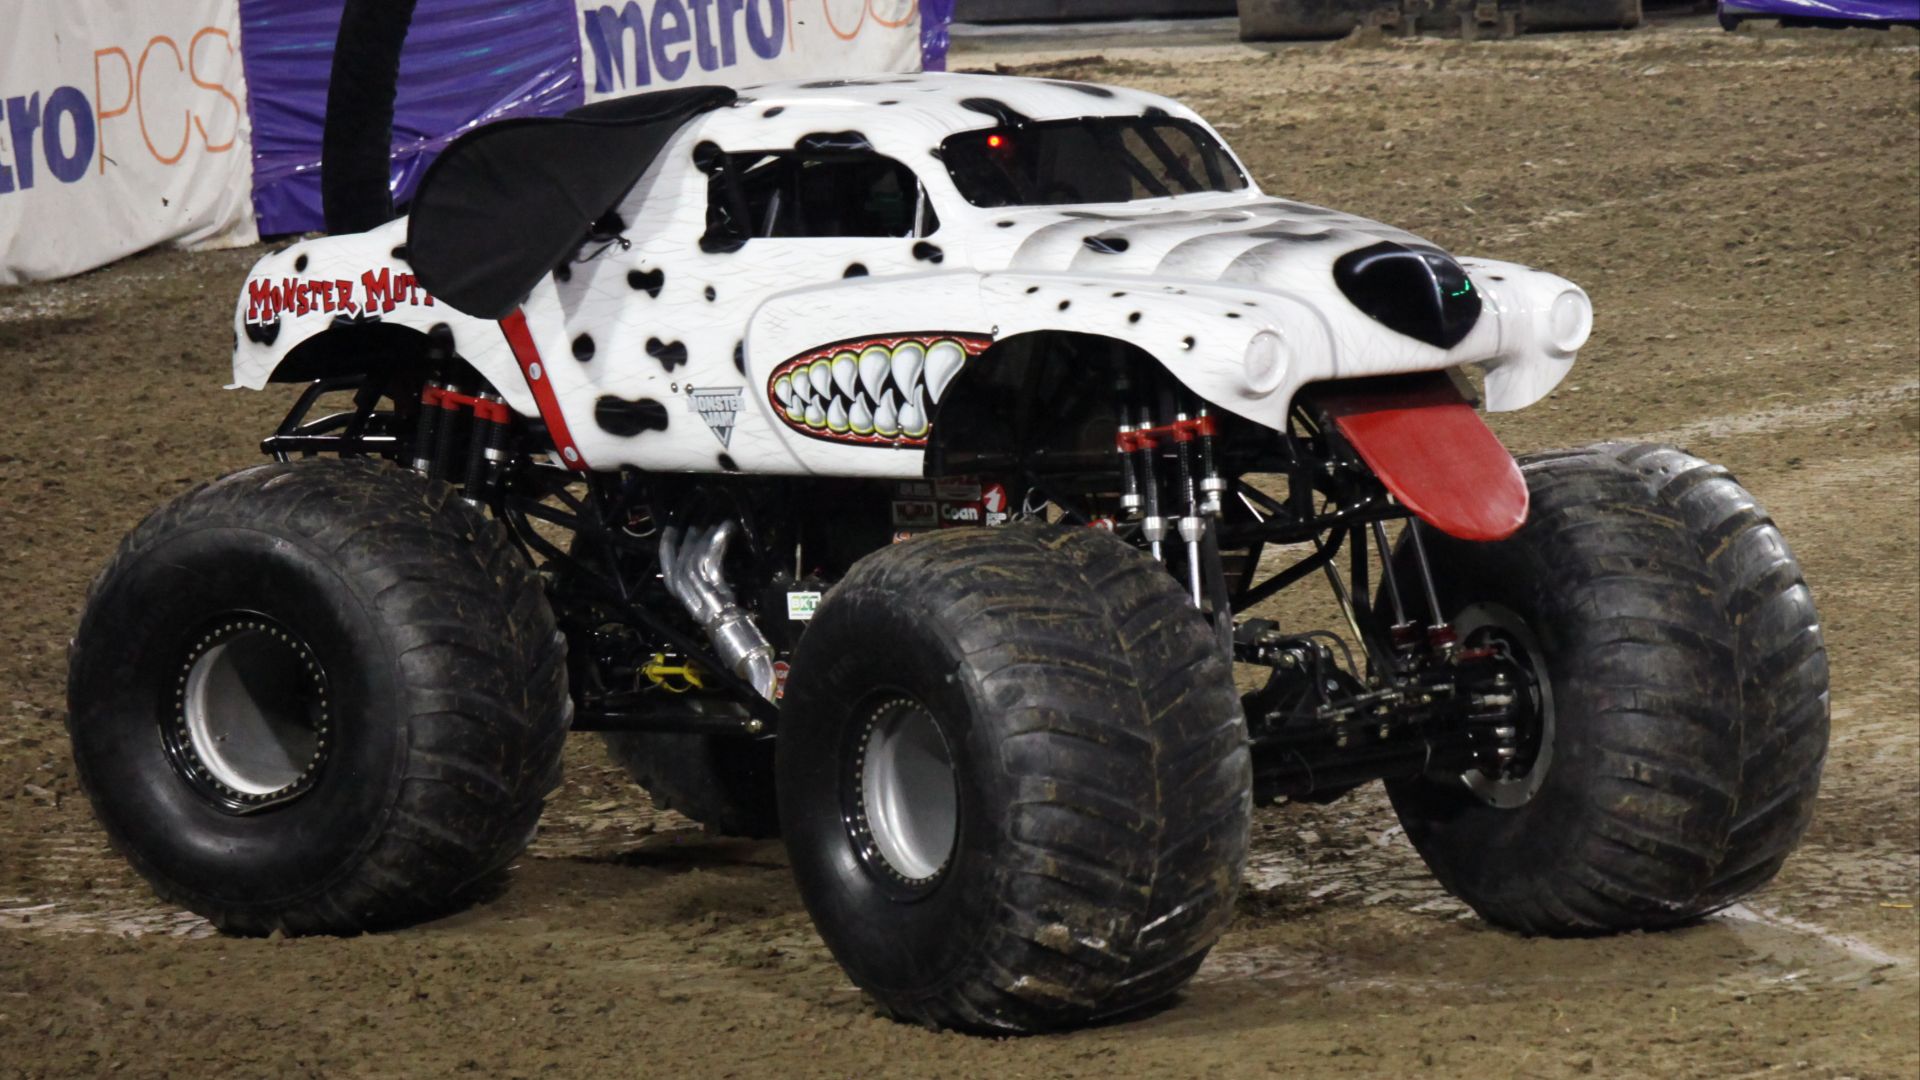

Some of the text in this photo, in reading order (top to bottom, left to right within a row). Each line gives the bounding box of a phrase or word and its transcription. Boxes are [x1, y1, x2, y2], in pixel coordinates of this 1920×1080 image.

[584, 0, 917, 93] metro
[940, 503, 979, 521] Coan
[791, 595, 818, 611] BKT
